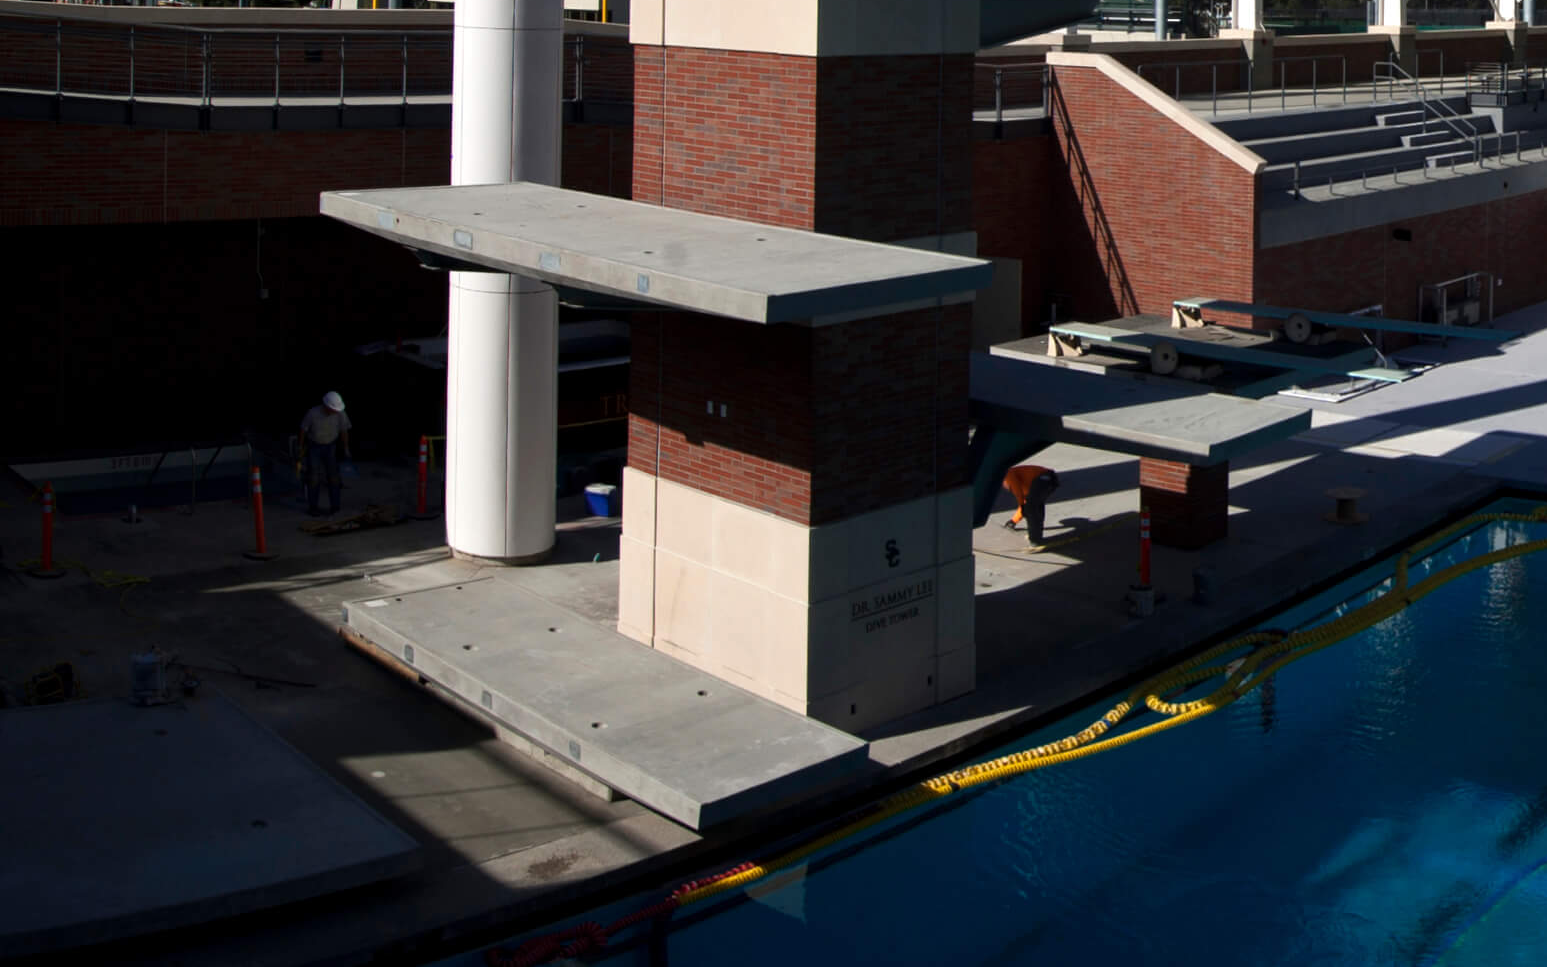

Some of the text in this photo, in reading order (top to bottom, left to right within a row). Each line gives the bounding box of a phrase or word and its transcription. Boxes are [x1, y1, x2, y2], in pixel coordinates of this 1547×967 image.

[874, 585, 913, 609] SAMMY
[916, 578, 934, 595] LEE
[865, 606, 920, 634] DIVE TOWER
